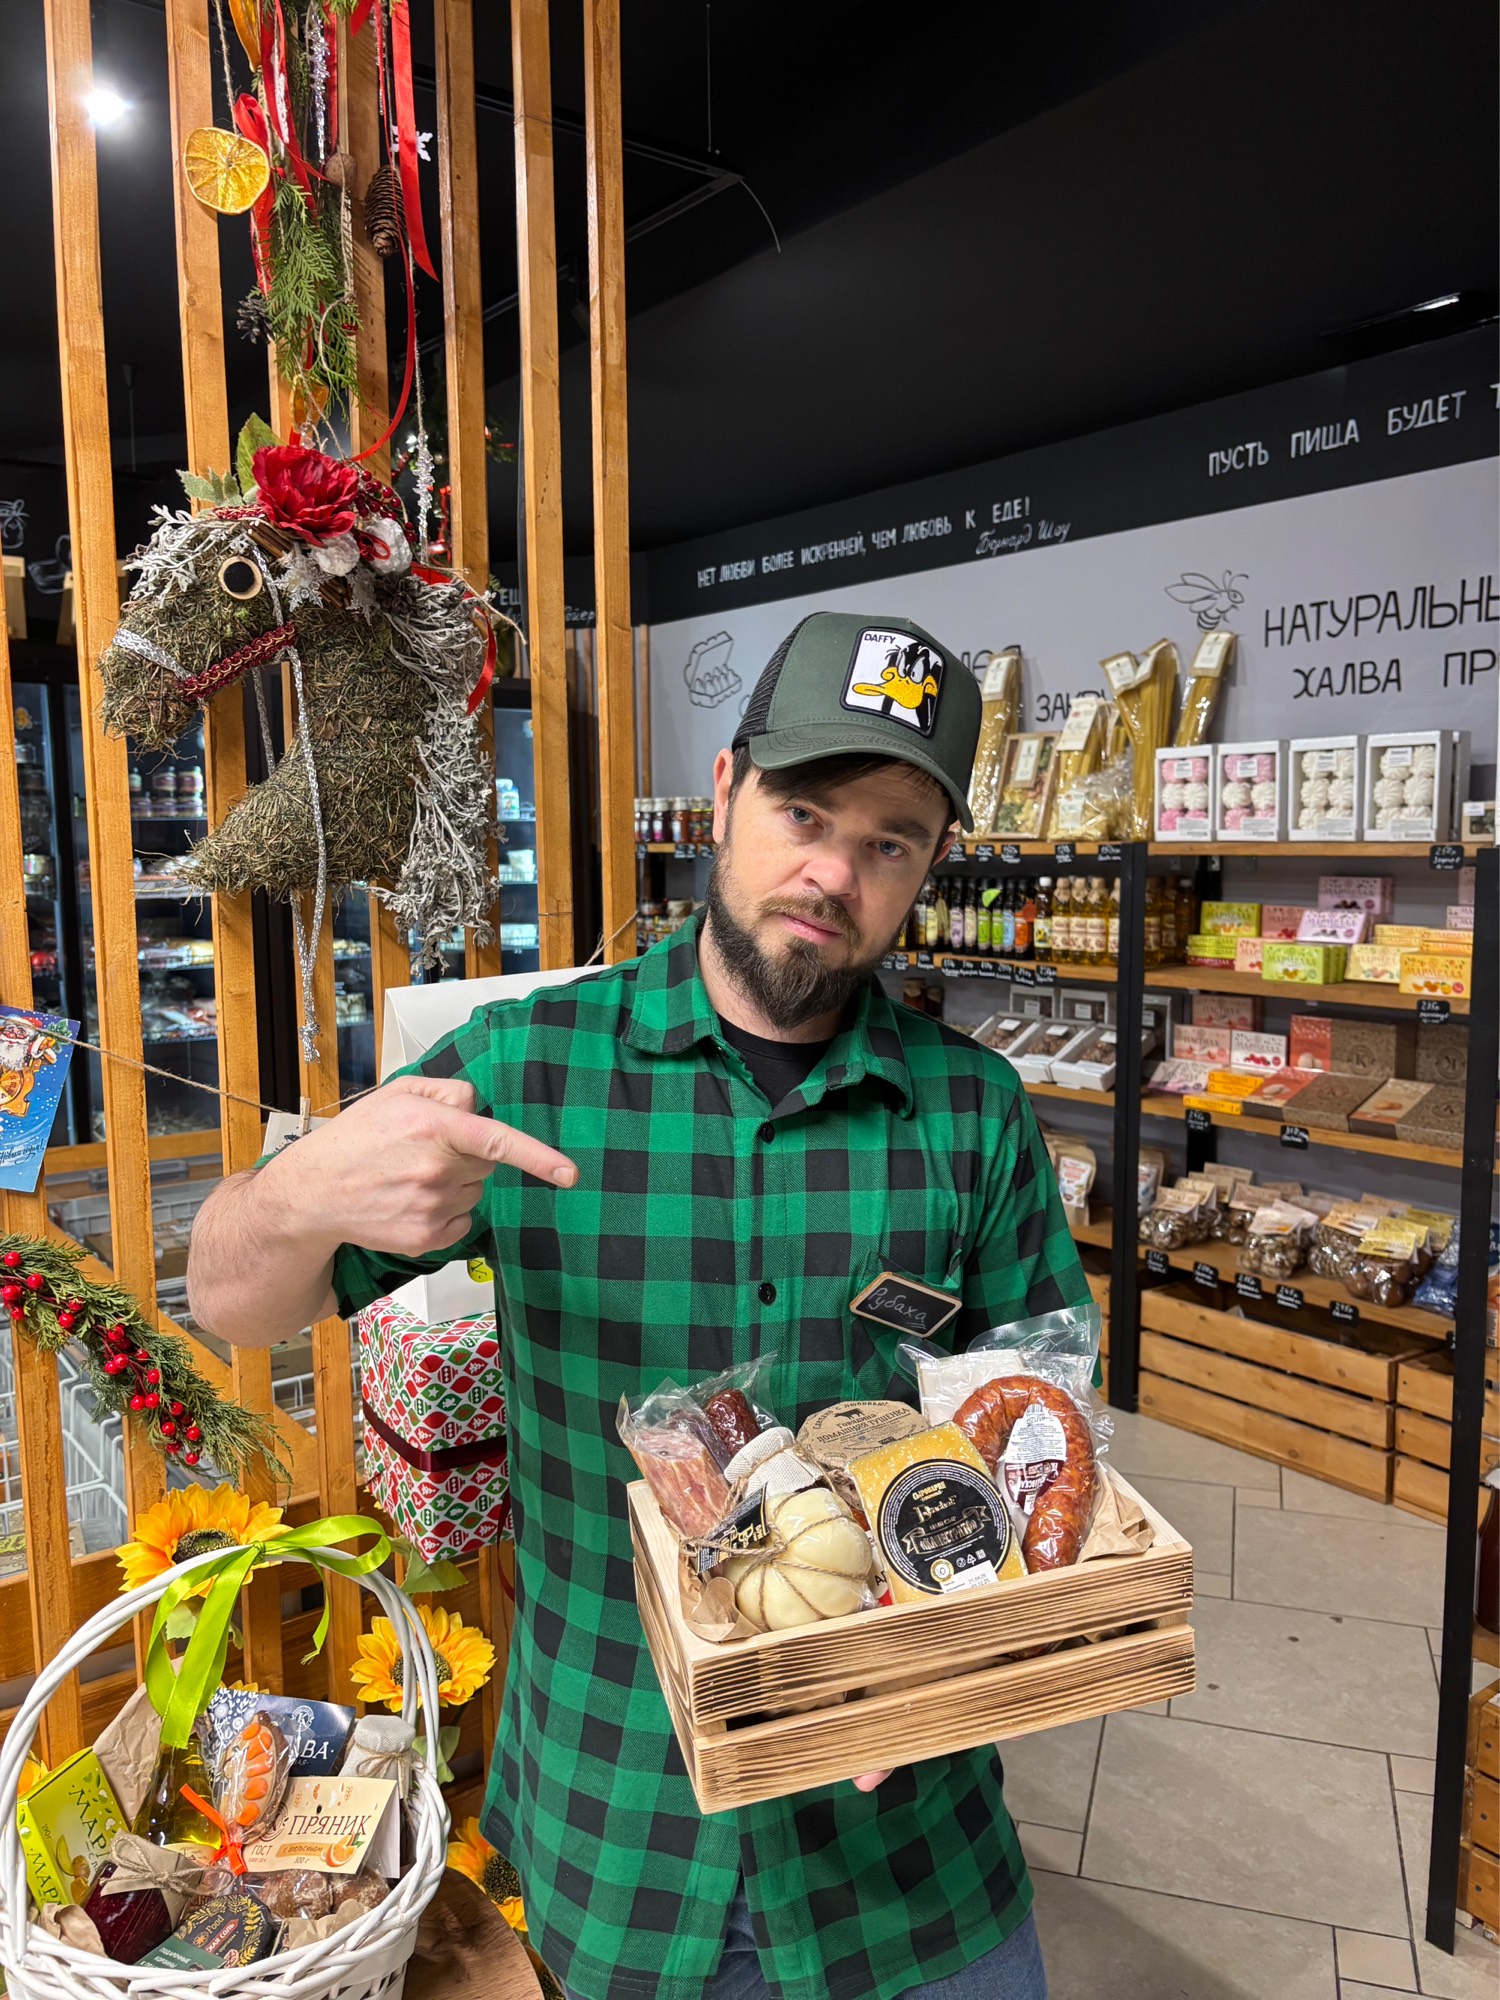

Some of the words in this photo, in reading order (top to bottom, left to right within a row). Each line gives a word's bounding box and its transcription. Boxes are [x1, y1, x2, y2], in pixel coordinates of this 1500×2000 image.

[1208, 441, 1270, 477] ПУСТЬ
[1387, 390, 1467, 436] БУДЕТ
[697, 567, 716, 589] НЕТ
[718, 559, 756, 584] ЛЮБВИ
[761, 552, 795, 574] БОЛЕЕ
[872, 528, 897, 550] ЧЕМ
[901, 516, 952, 544] ЛЮБОВЬ
[965, 510, 977, 529] К
[992, 496, 1031, 525] ЕДЕ!
[864, 633, 896, 645] DAFFY
[1292, 658, 1402, 700] ХАЛВА
[1443, 648, 1497, 688] ПР
[868, 1287, 928, 1323] Рубаха
[288, 1815, 371, 1836] ПРЯНИК
[251, 1844, 273, 1857] ГОСТ
[207, 1914, 225, 1935] Food
